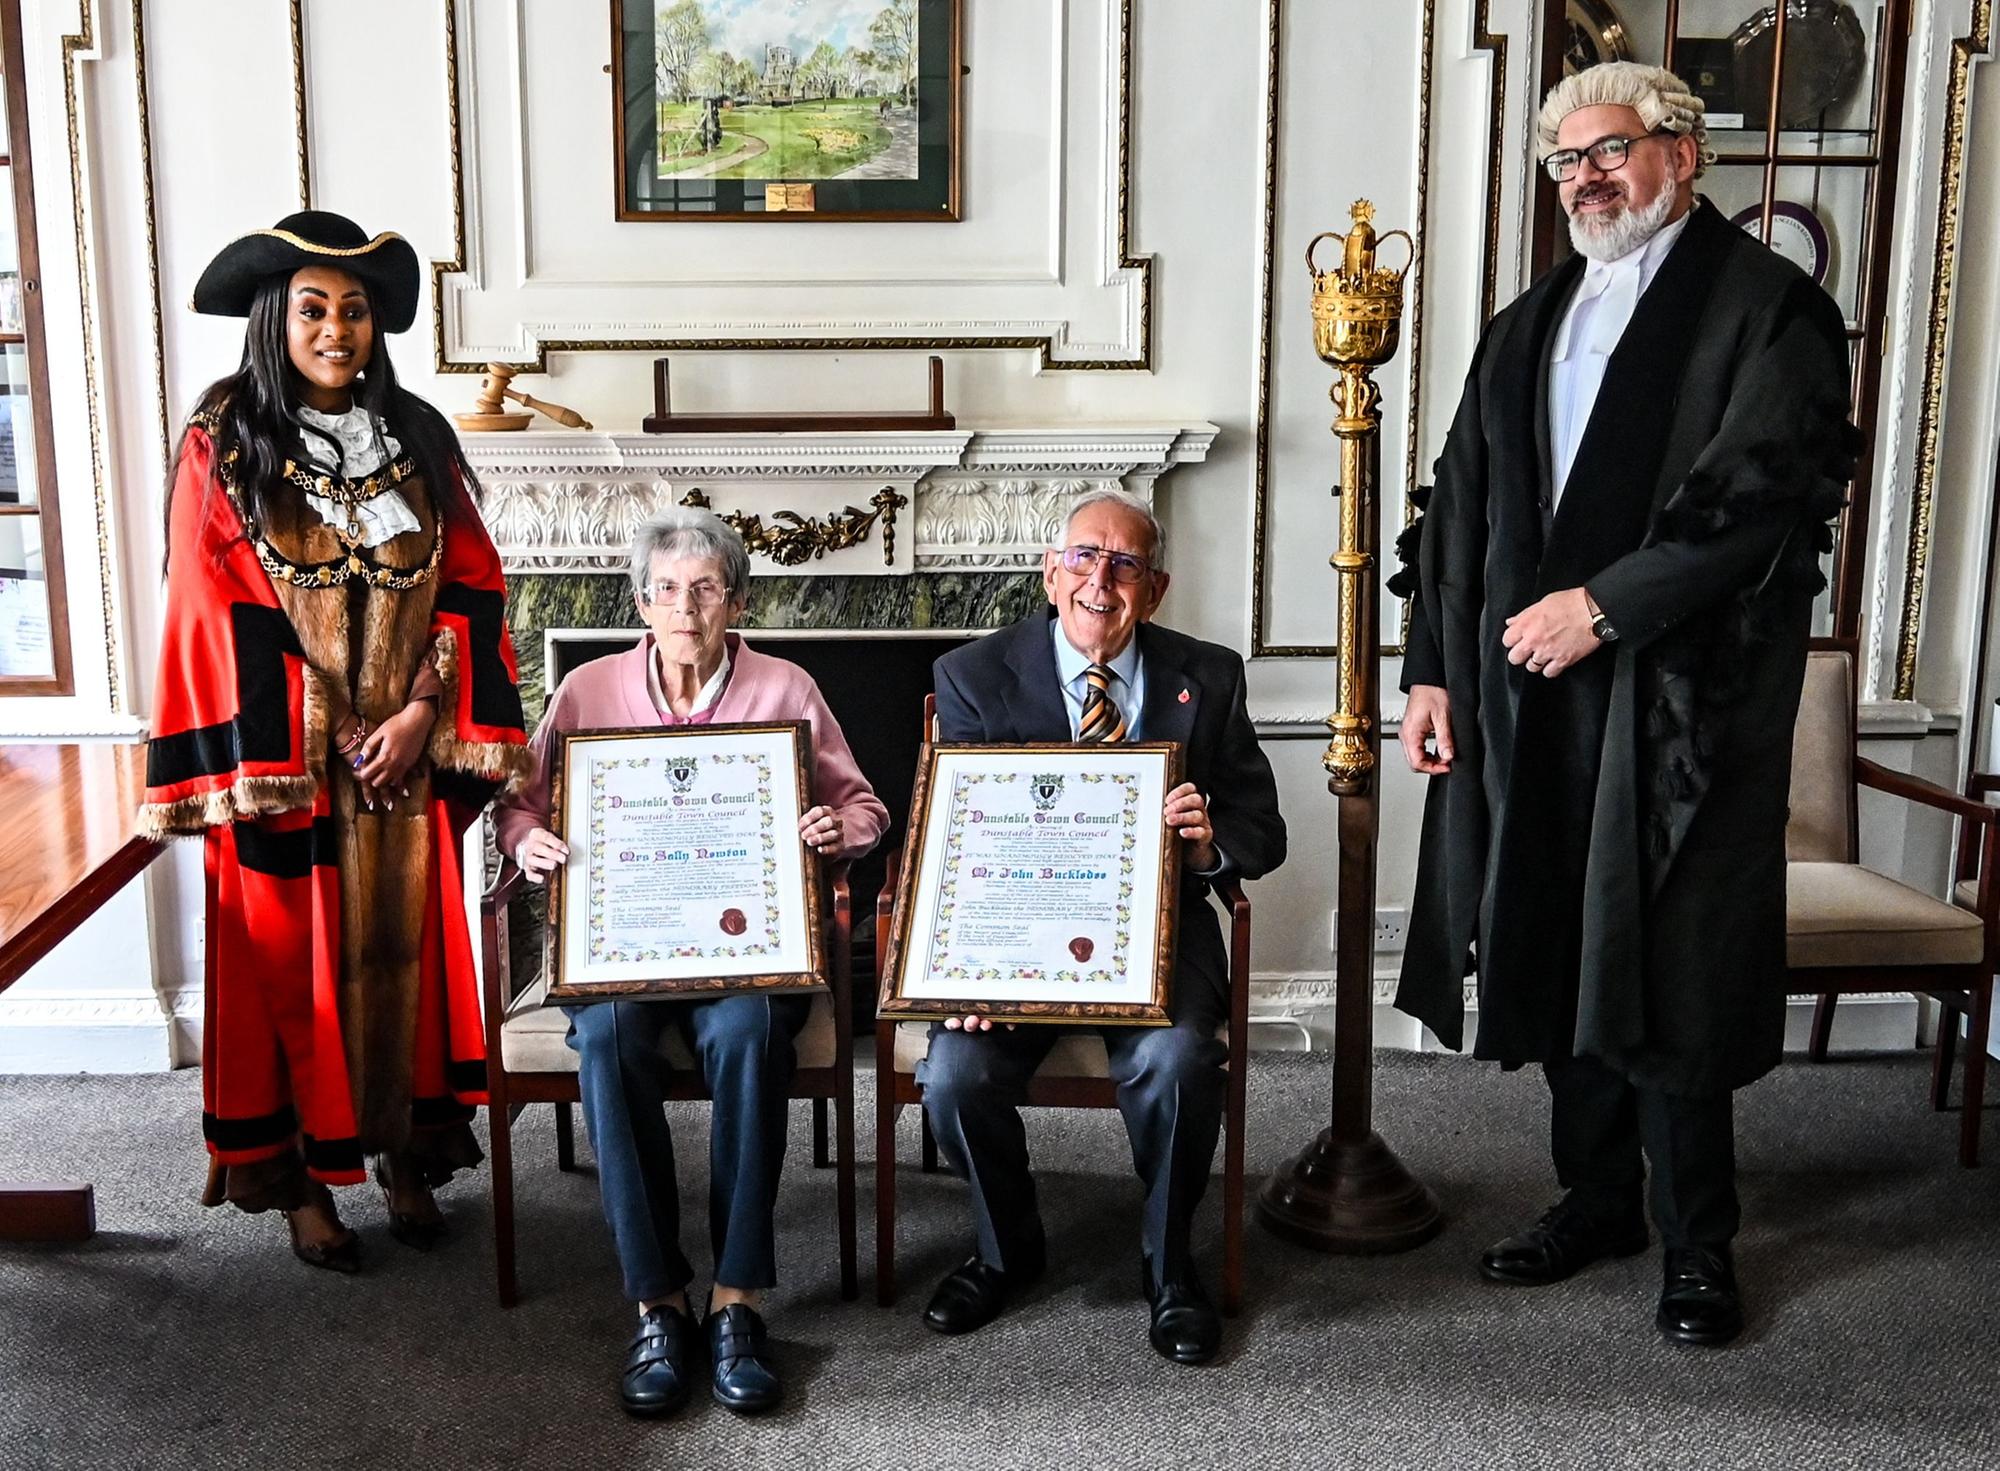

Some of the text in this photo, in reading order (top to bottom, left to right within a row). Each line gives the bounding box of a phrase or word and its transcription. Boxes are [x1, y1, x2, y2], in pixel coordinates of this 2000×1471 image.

[608, 792, 755, 809] Dunstable Town Council
[622, 813, 673, 822] Dunstable
[708, 808, 748, 818] Council
[968, 810, 1120, 825] Dunstable Town Council
[619, 851, 650, 863] Mrs
[653, 849, 690, 863] Sally
[694, 848, 747, 860] Newton
[971, 866, 1107, 880] Mr John Buckledee
